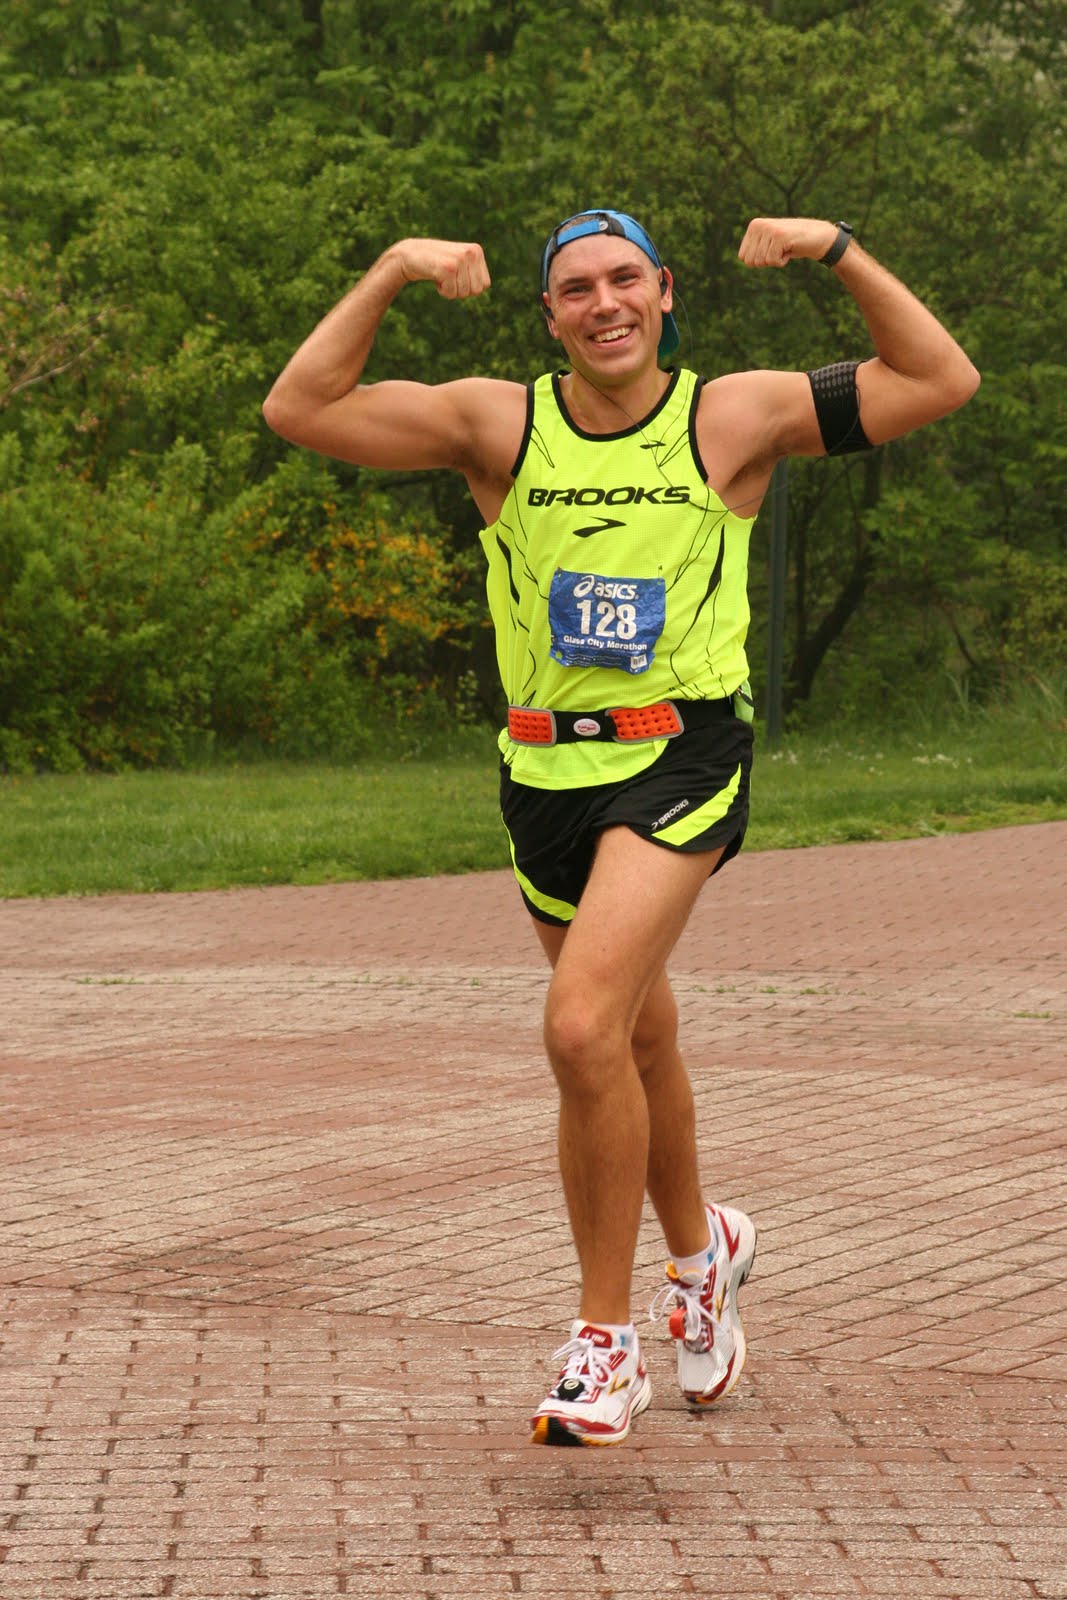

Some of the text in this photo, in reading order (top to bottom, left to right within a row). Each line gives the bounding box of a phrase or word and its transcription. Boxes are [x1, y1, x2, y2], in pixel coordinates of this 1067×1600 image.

[527, 486, 691, 507] BROOKS
[576, 599, 637, 640] 128
[563, 635, 648, 651] Glass City Marathon
[658, 799, 690, 825] BROOKS
